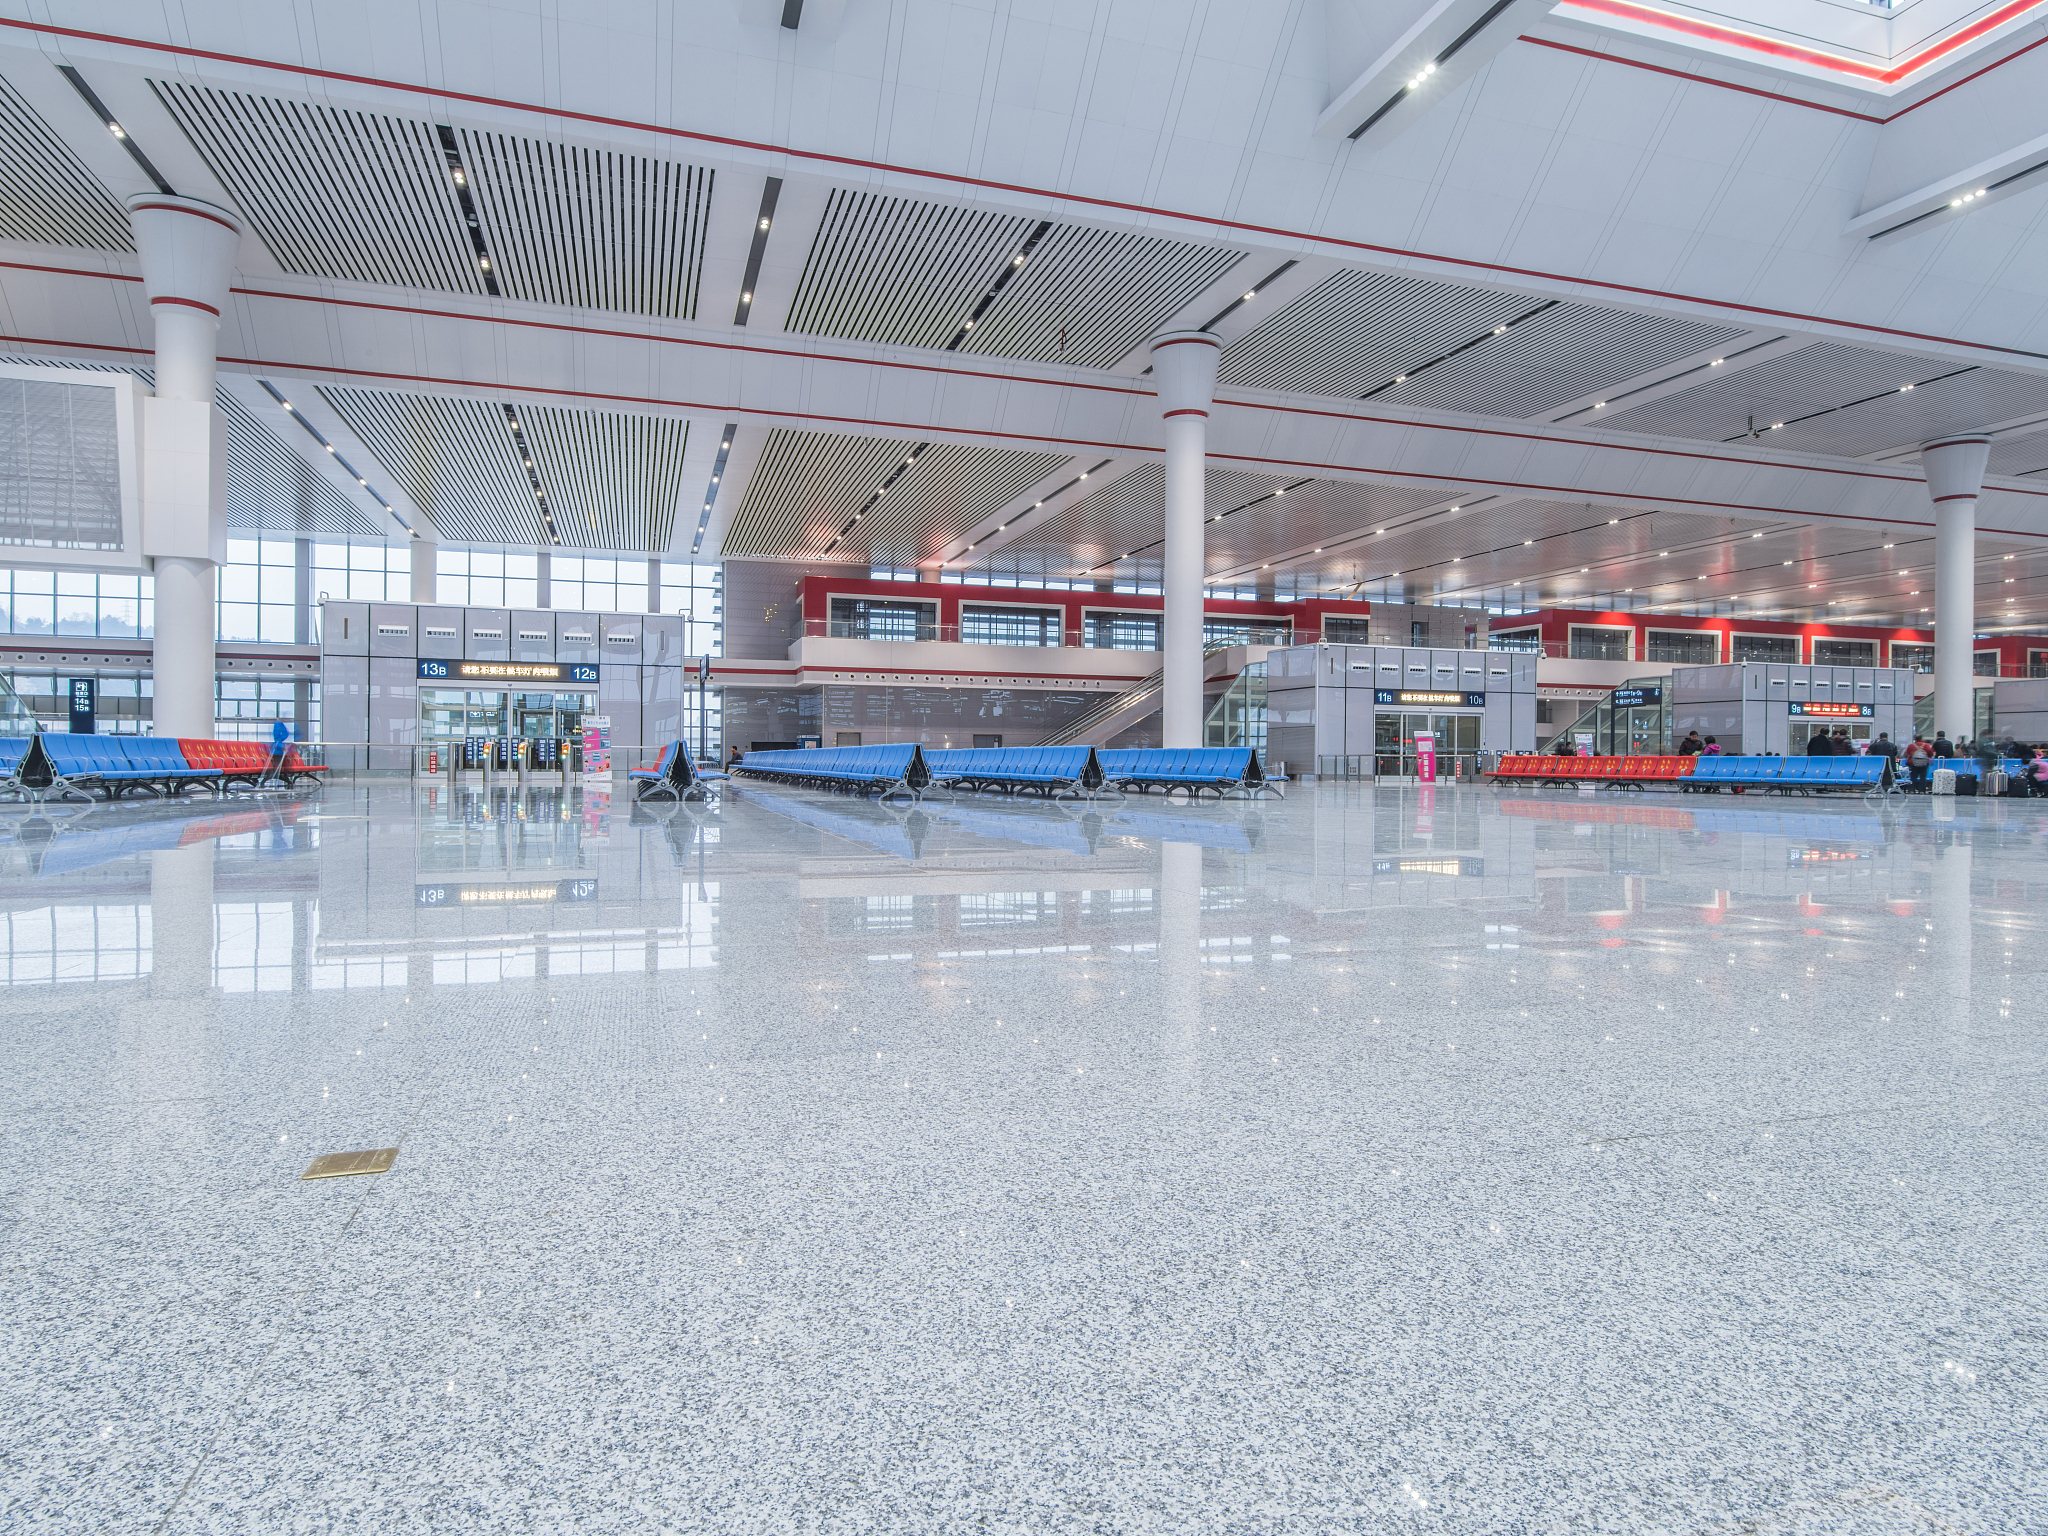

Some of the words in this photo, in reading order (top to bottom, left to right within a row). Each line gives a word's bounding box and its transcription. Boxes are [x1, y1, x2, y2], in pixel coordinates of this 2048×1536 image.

[421, 663, 447, 676] 13B
[573, 667, 597, 680] 12B
[1377, 692, 1392, 702] 11B
[1469, 695, 1483, 705] 10B
[1791, 704, 1801, 714] 9B
[1862, 706, 1872, 715] 8B
